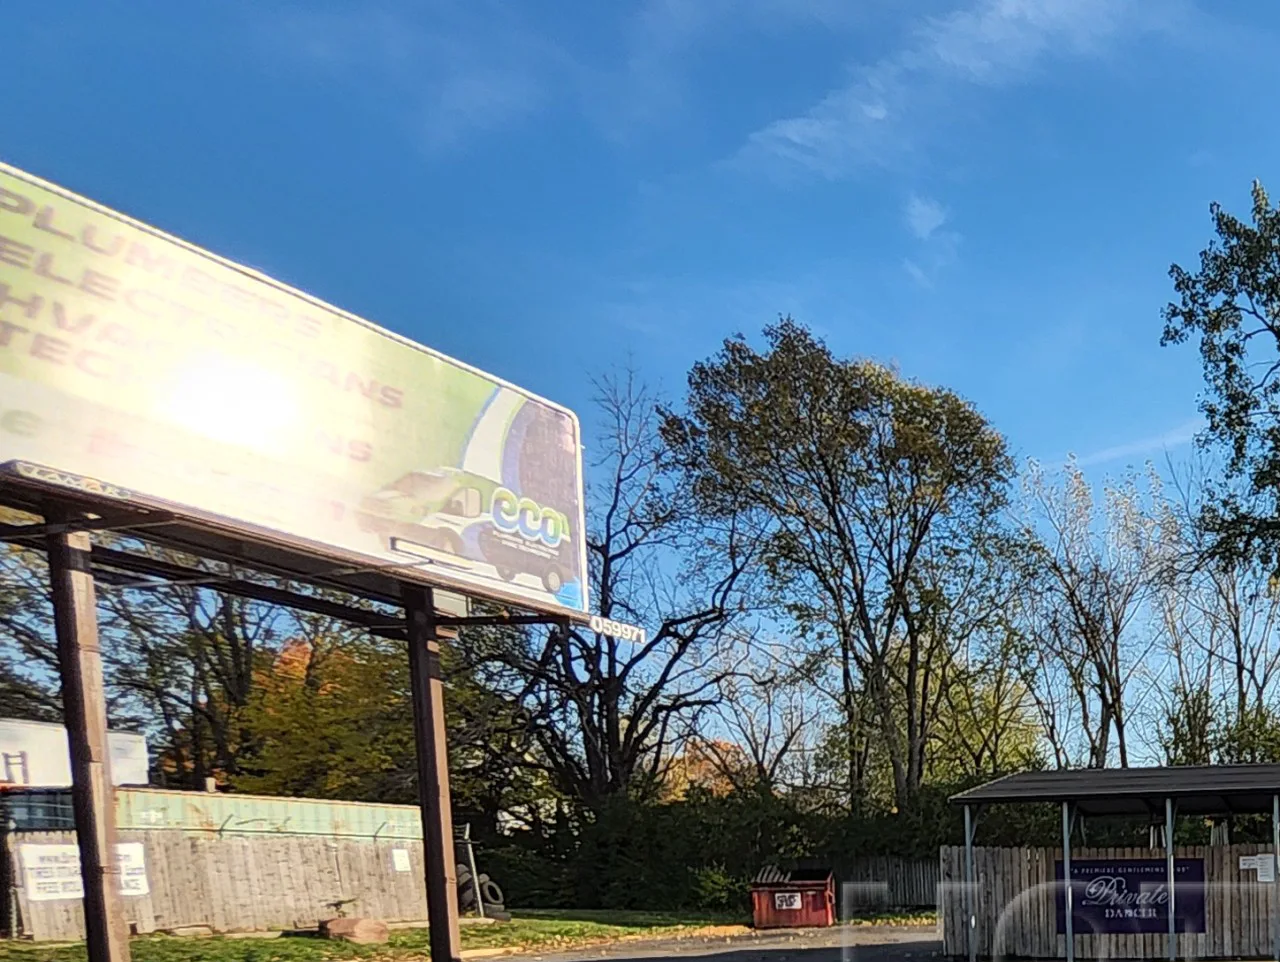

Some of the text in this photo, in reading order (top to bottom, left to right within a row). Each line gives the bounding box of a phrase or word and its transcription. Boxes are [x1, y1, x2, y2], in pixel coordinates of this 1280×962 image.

[0, 236, 406, 411] ELECTRCANS
[491, 486, 563, 548] eco
[590, 616, 646, 643] 059971
[1082, 875, 1170, 907] Private
[1105, 908, 1157, 919] DANCER
